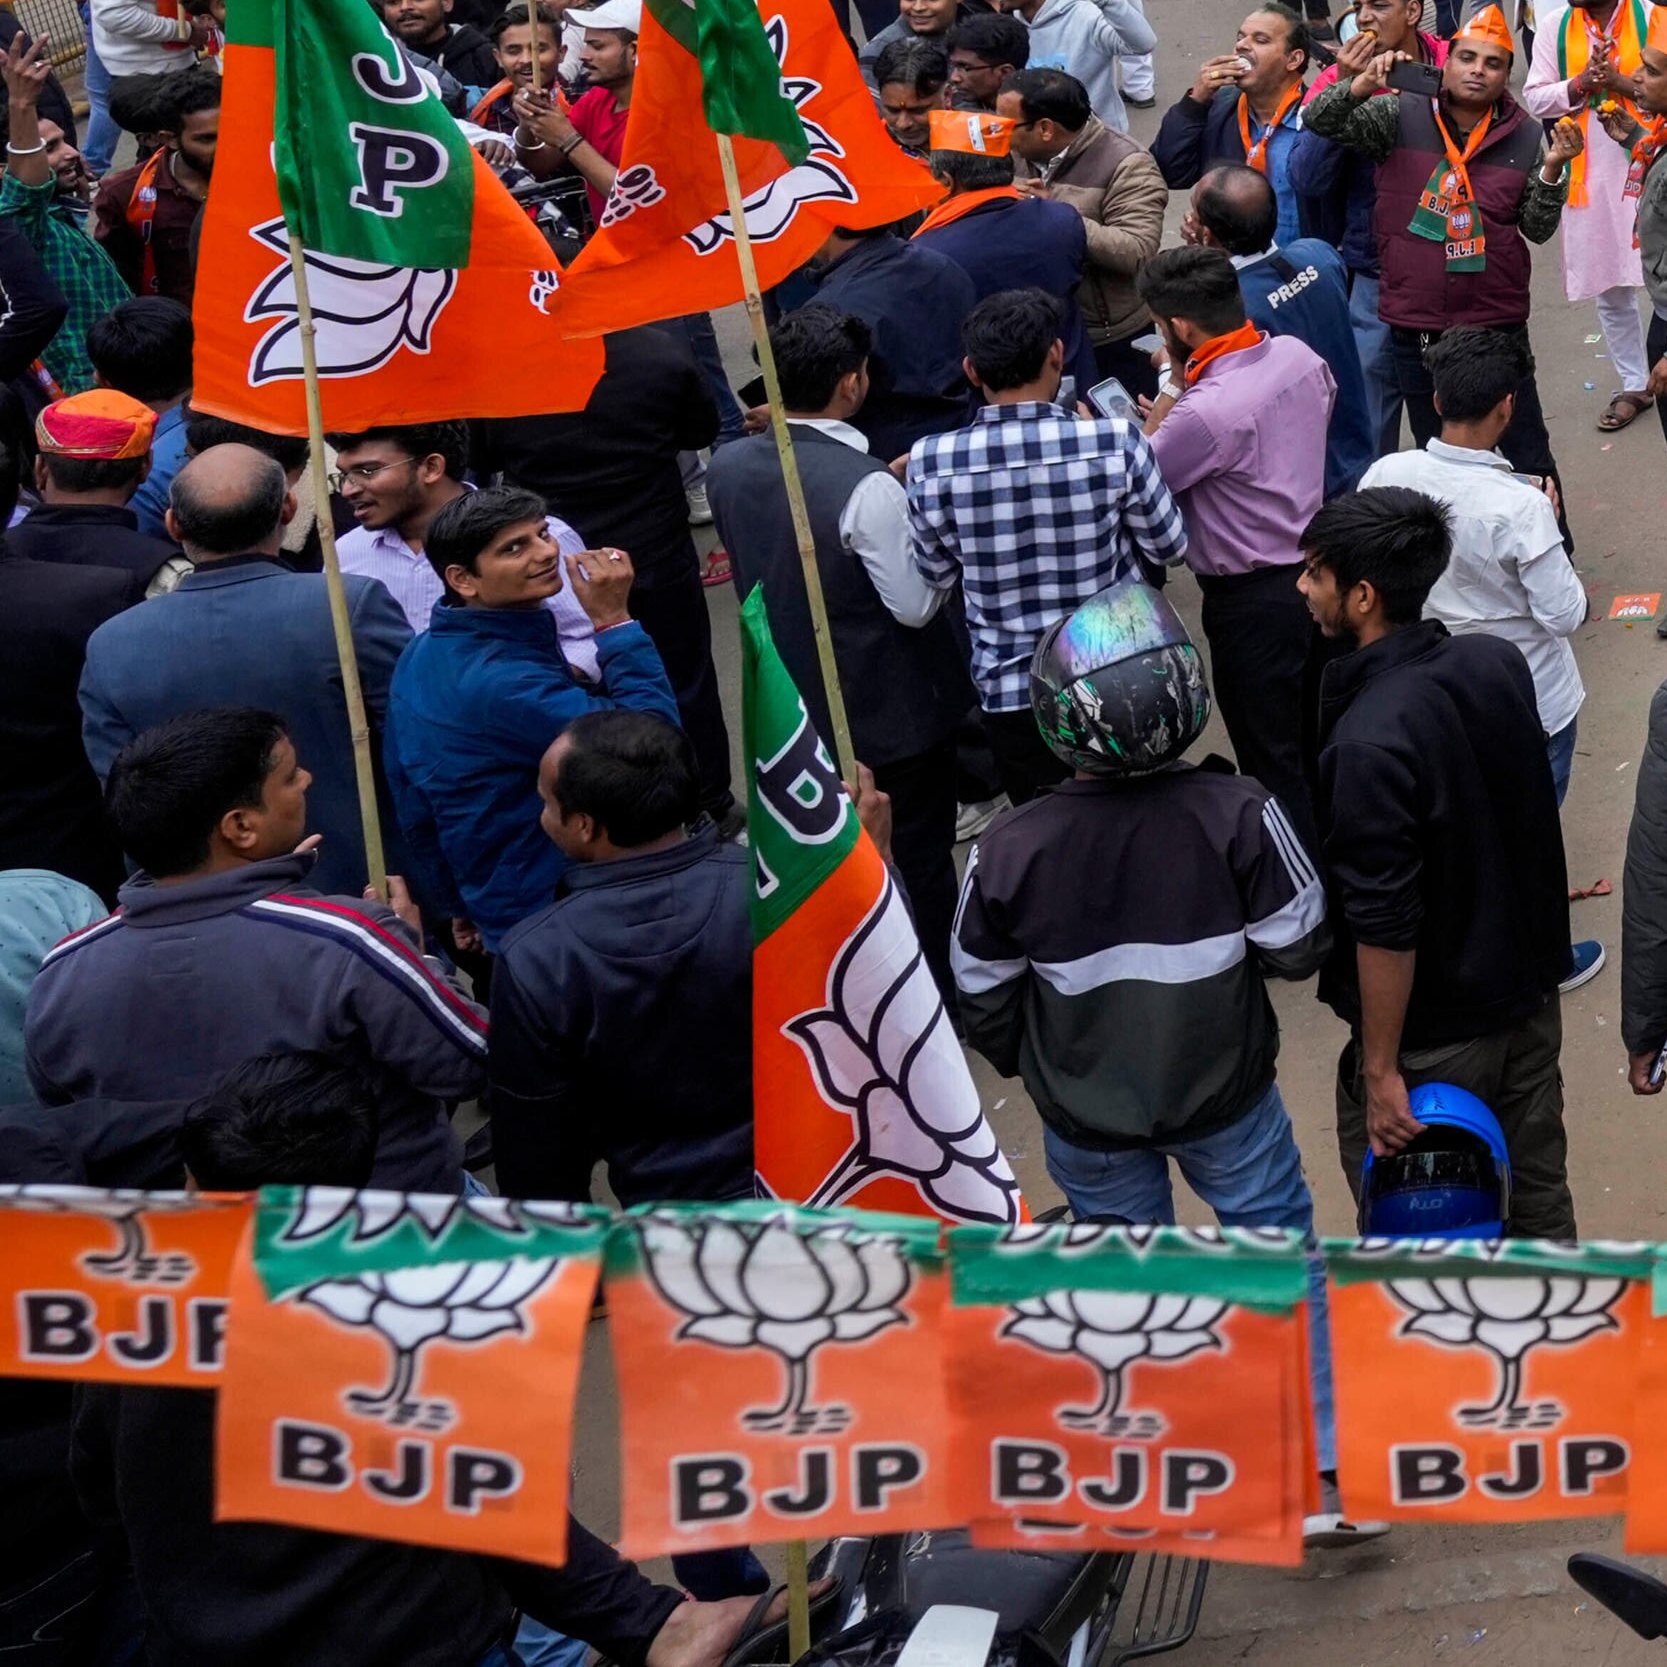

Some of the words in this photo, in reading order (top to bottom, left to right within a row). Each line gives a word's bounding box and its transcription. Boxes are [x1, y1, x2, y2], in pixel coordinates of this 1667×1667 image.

[1266, 264, 1320, 310] PRESS
[275, 1420, 520, 1513] BJP
[673, 1445, 926, 1527] BJP
[991, 1438, 1236, 1514] BJP
[1391, 1437, 1630, 1505] BJP
